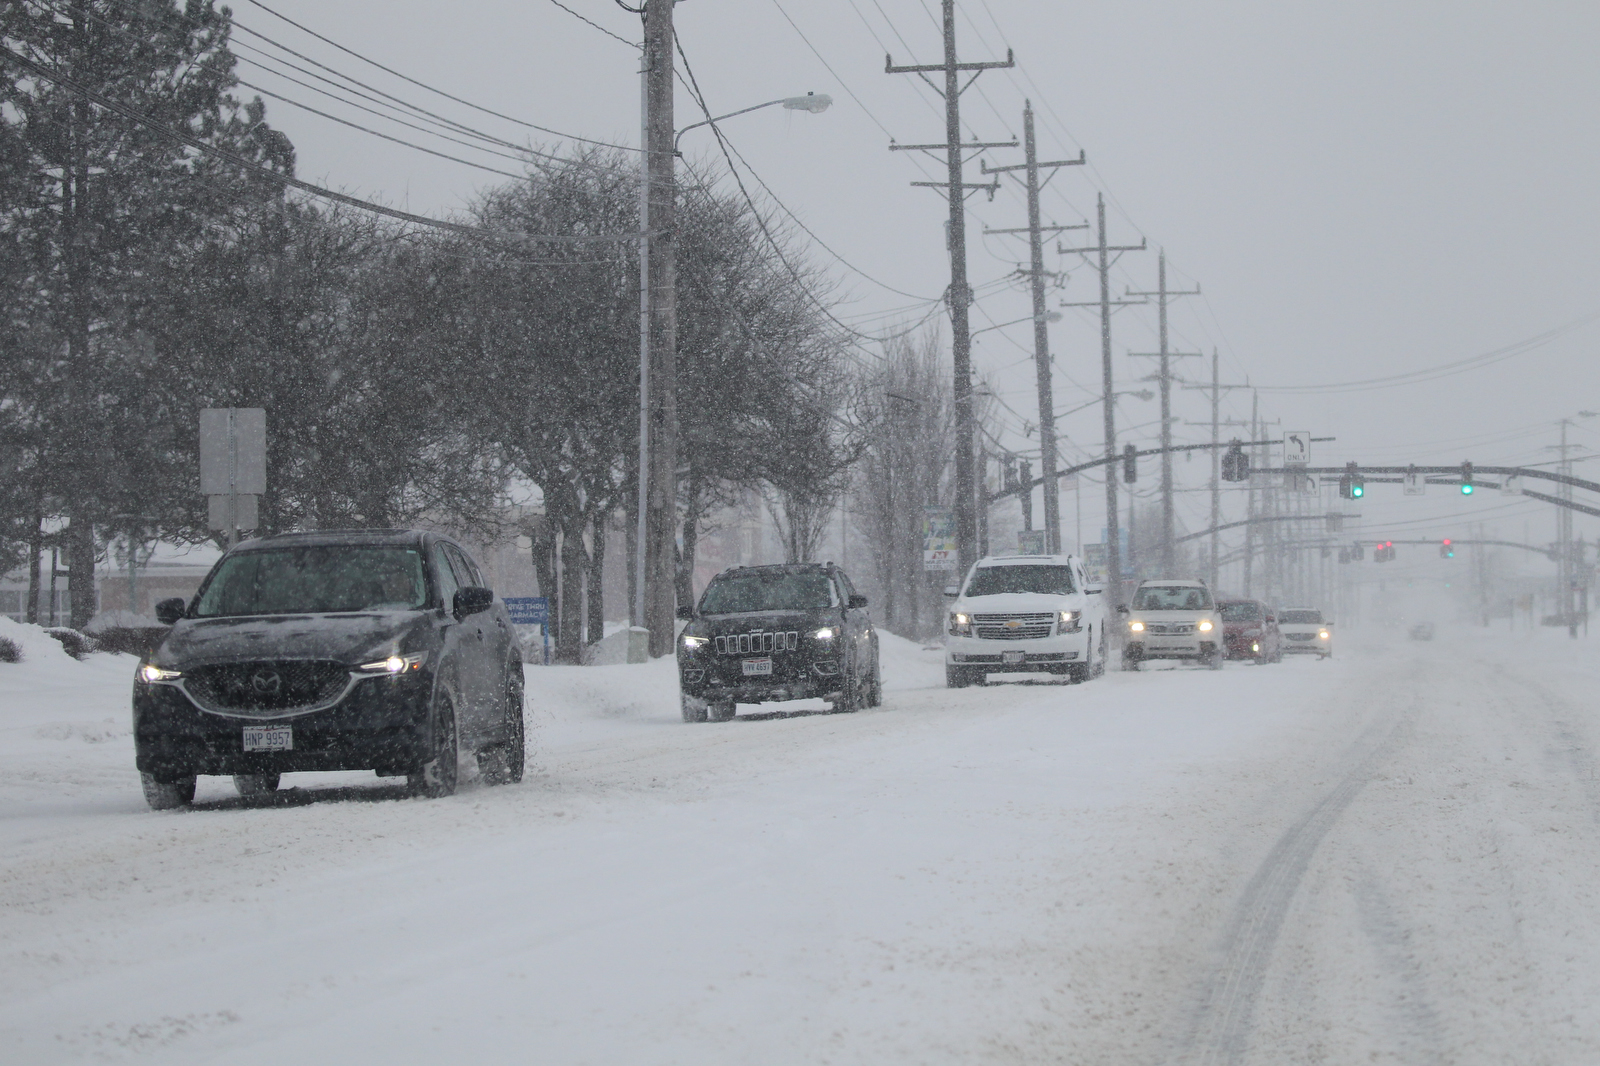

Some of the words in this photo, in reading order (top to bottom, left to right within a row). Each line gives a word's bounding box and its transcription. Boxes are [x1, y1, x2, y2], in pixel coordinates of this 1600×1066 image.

[756, 662, 770, 671] 4697
[245, 732, 263, 746] HNP
[266, 731, 290, 746] 9957
